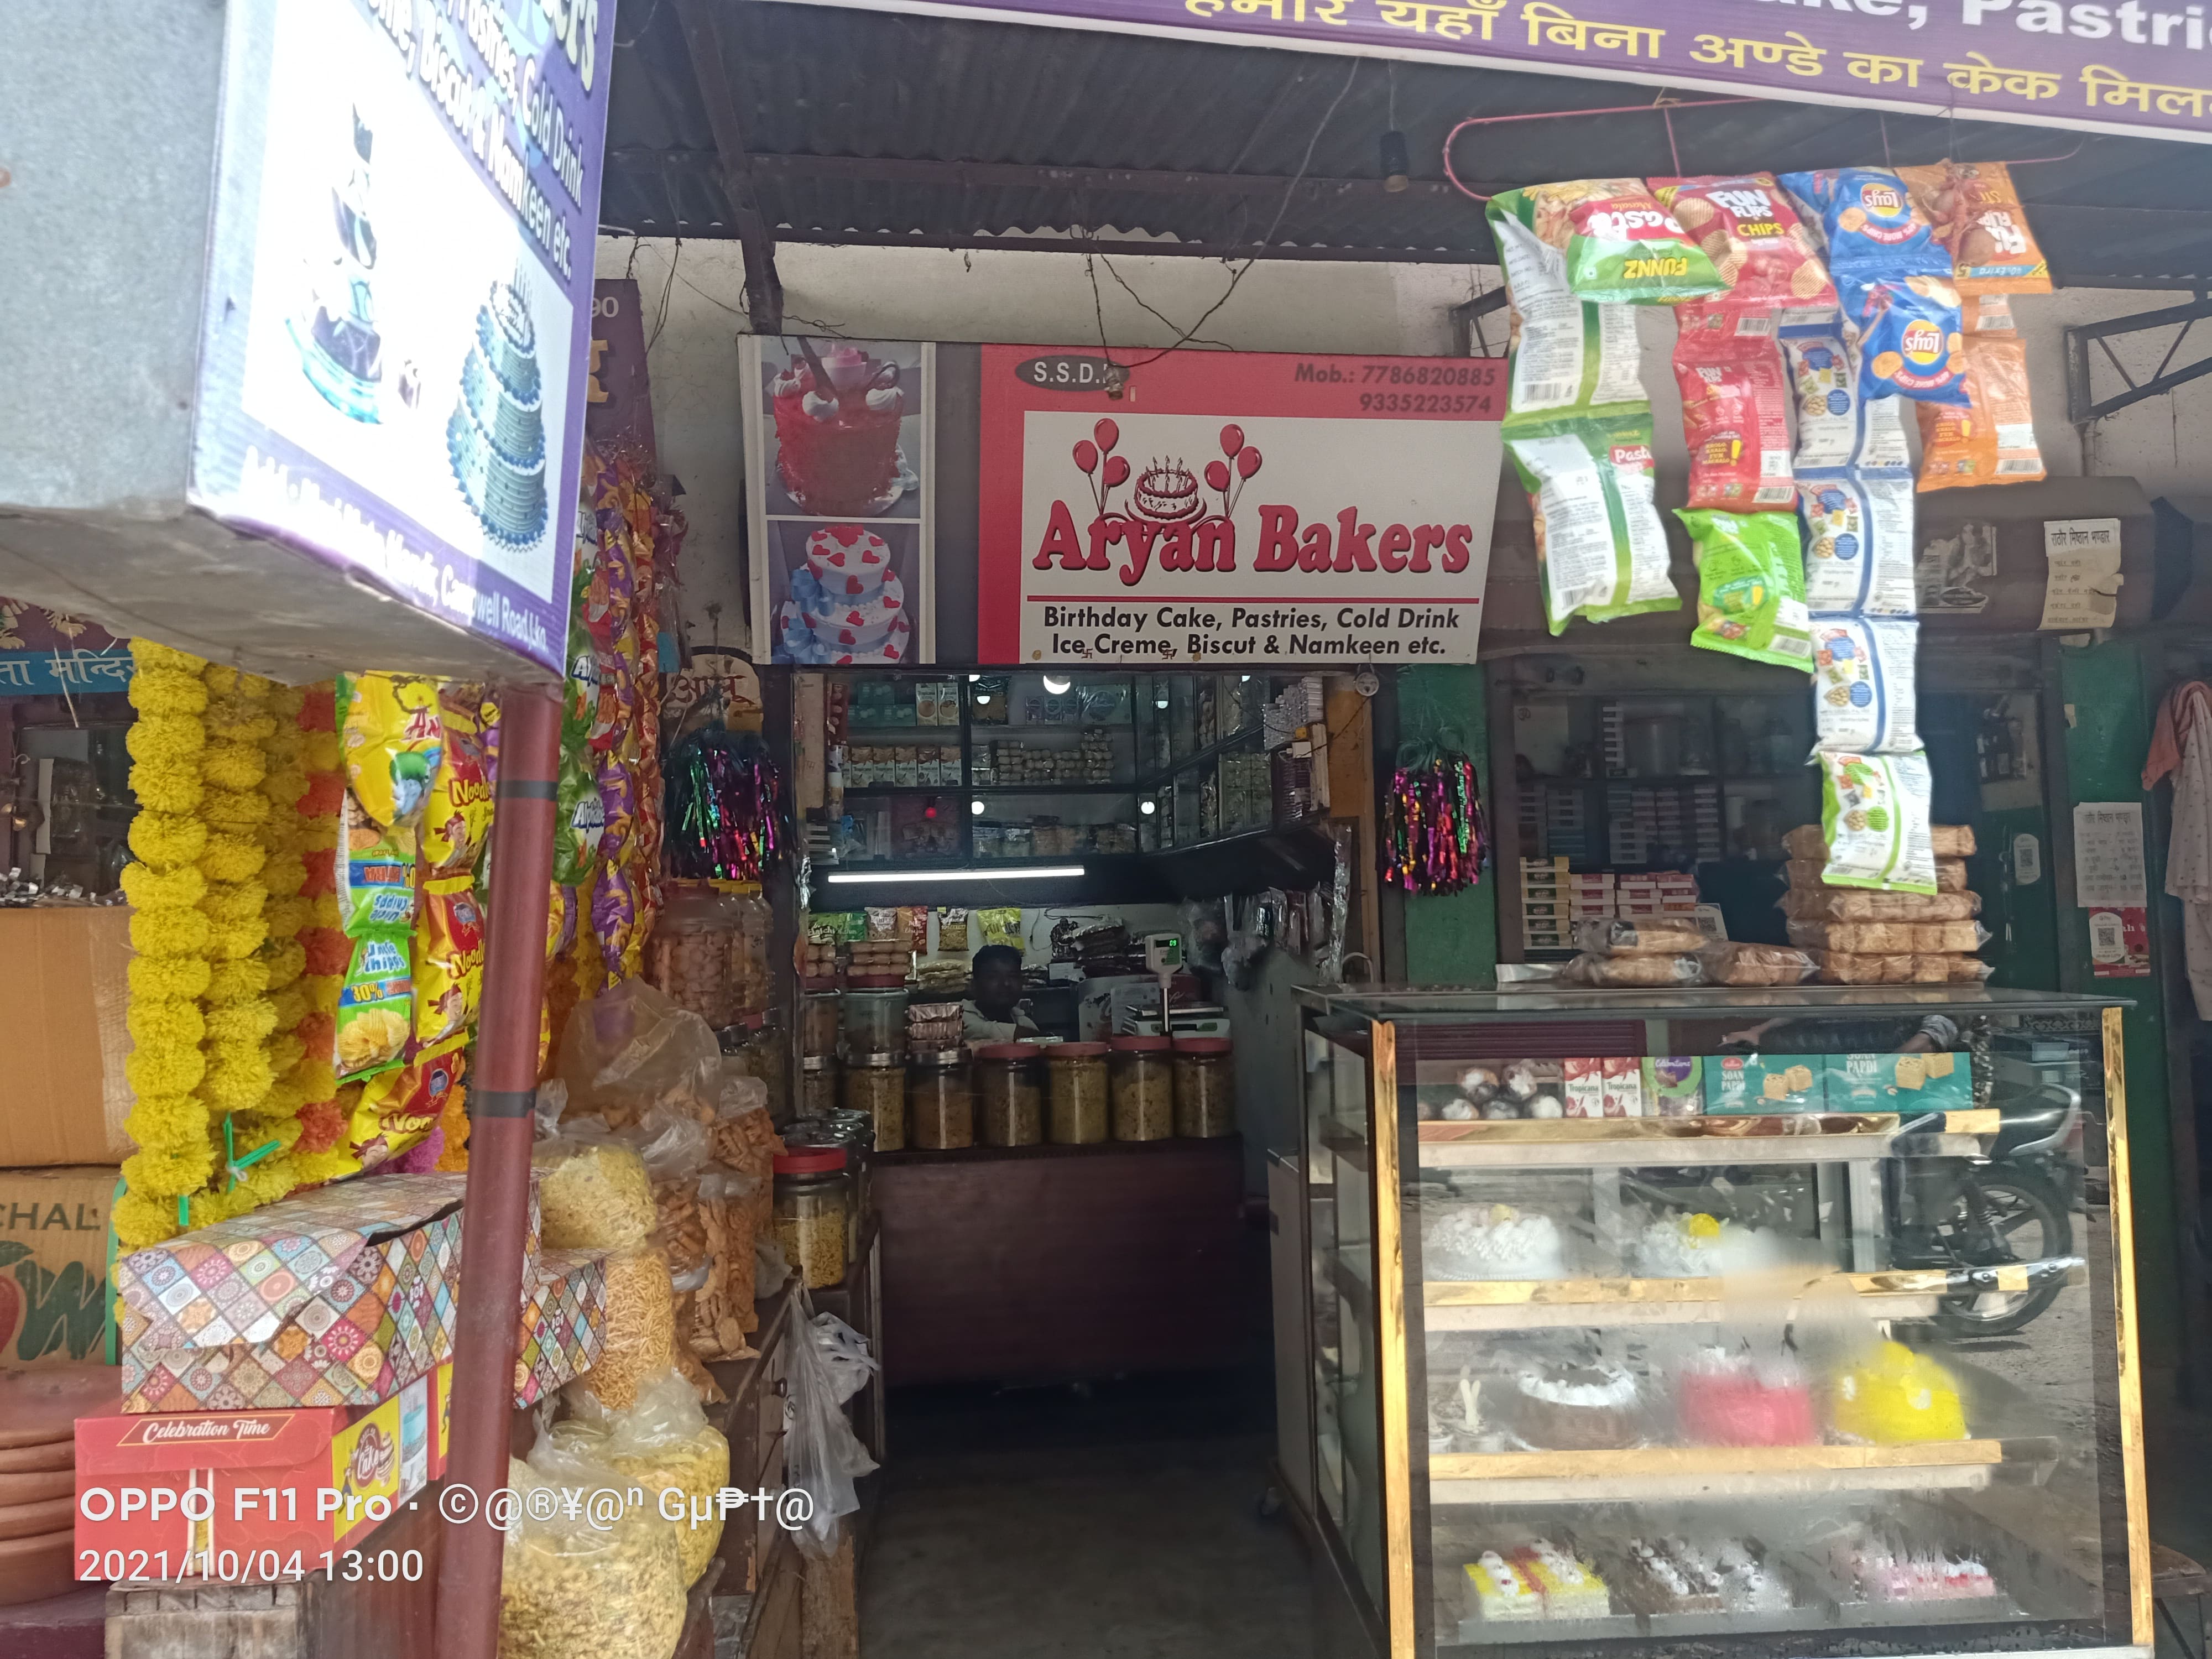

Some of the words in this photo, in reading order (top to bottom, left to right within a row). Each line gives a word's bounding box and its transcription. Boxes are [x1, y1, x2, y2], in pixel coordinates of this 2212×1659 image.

[1962, 0, 2212, 50] Pastri
[1521, 1, 1666, 58] बिना
[1689, 30, 1827, 77] अण्डे
[1843, 51, 1924, 88] का
[1943, 51, 2062, 101] केक
[2079, 64, 2212, 118] मिल
[522, 58, 553, 156] Cold
[552, 107, 583, 208] Drink
[487, 102, 552, 250] Namkeen
[553, 216, 572, 280] etc.
[1705, 189, 1771, 208] FUN
[1730, 205, 1774, 218] FLIPS
[1736, 222, 1786, 237] CHIPS
[1623, 257, 1688, 279] FUNNZ
[1034, 361, 1117, 384] S.S.D.
[1294, 362, 1354, 383] Mob.:
[1361, 365, 1496, 387] 7786820885
[1359, 393, 1491, 413] 9335223574
[1032, 500, 1237, 586] Aryan
[1253, 504, 1473, 573] Bakers
[1043, 607, 1147, 633] Birthday
[1156, 608, 1222, 632] Cake,
[1231, 608, 1328, 632] Pastries,
[1337, 608, 1390, 629] Cold
[1397, 608, 1460, 629] Drink
[1094, 633, 1178, 658] Creme,
[1187, 634, 1256, 655] Biscut
[1263, 635, 1280, 655] &
[1289, 635, 1402, 655] Namkeen
[1407, 636, 1446, 655] etc.
[402, 863, 416, 888] 0%
[368, 909, 399, 923] Uncle
[351, 980, 384, 1003] 30%
[1721, 1070, 1744, 1081] SOAN
[1846, 1060, 1877, 1074] PAPDI
[1568, 1083, 1599, 1093] Tropicana
[1607, 1082, 1637, 1091] Tropicana
[142, 1418, 229, 1444] Celebration
[232, 1420, 272, 1440] Time
